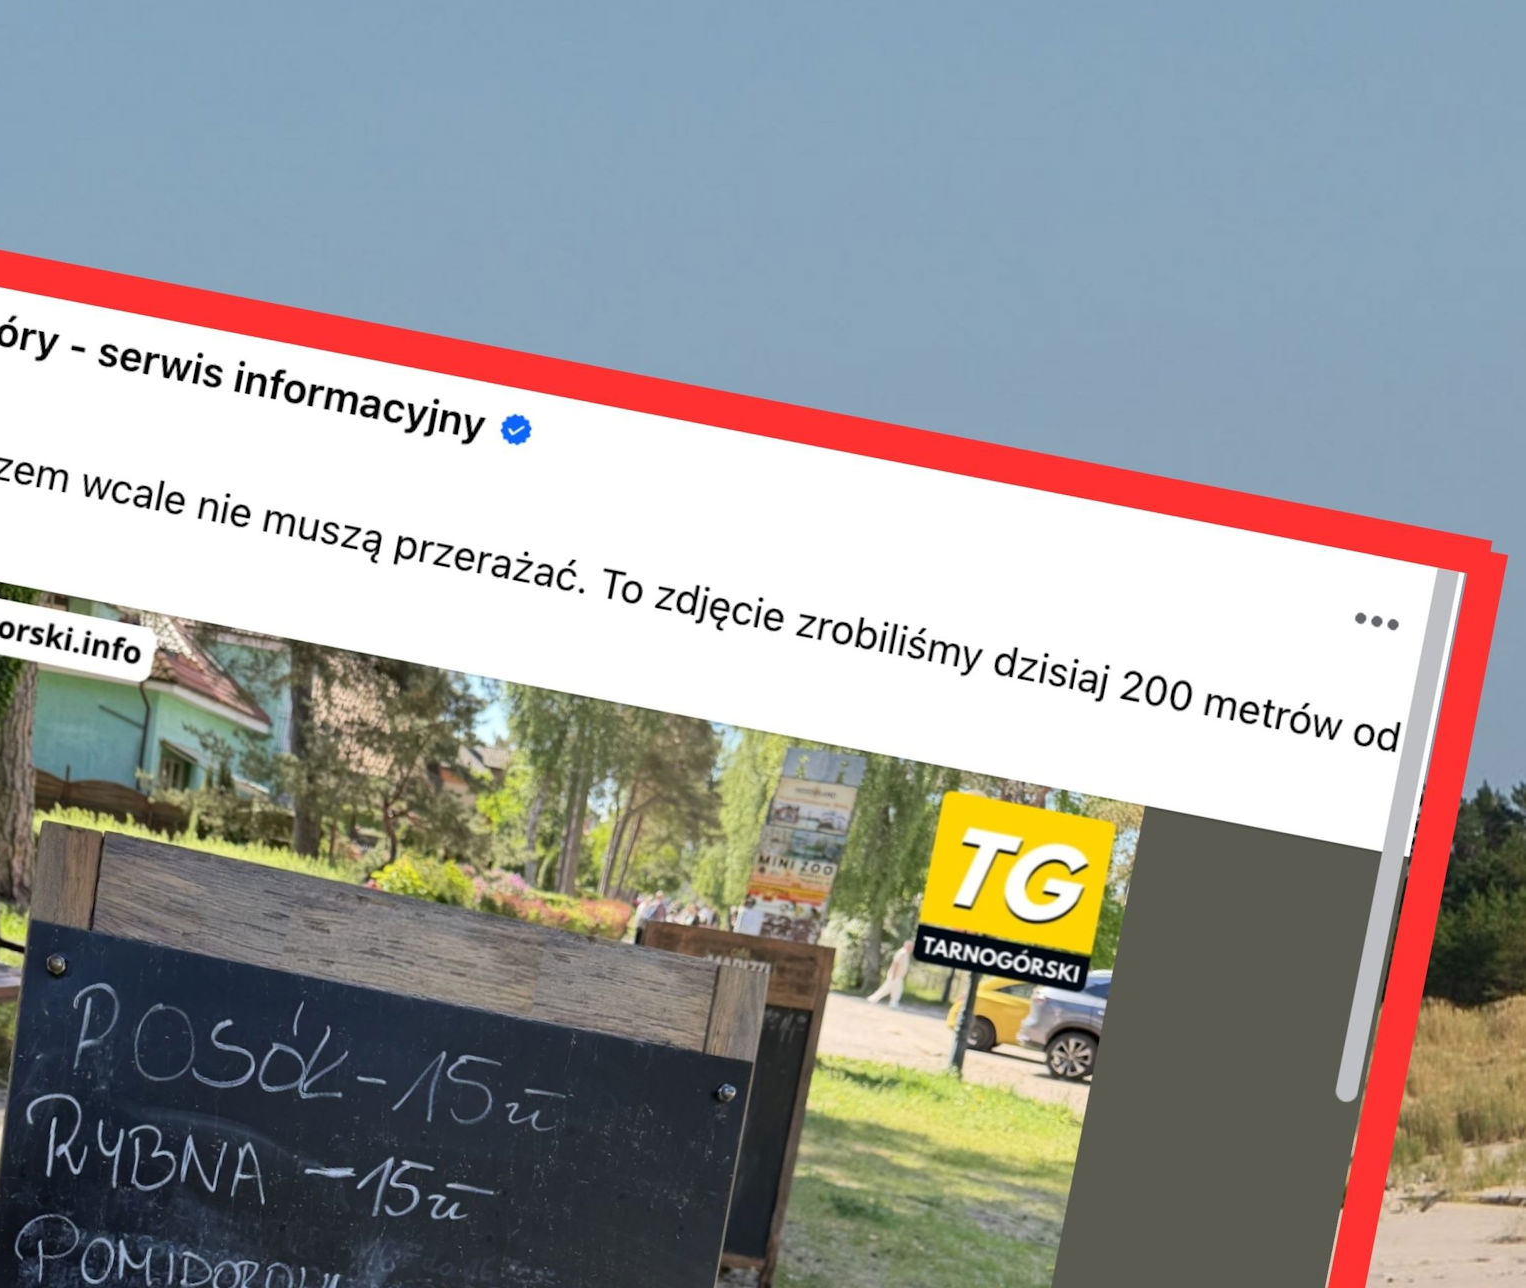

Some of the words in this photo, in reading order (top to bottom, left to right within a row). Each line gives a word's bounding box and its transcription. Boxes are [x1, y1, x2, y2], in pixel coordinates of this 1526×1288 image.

[757, 854, 795, 870] MINI
[799, 860, 834, 876] ZOO
[26, 1093, 266, 1205] RYBNA
